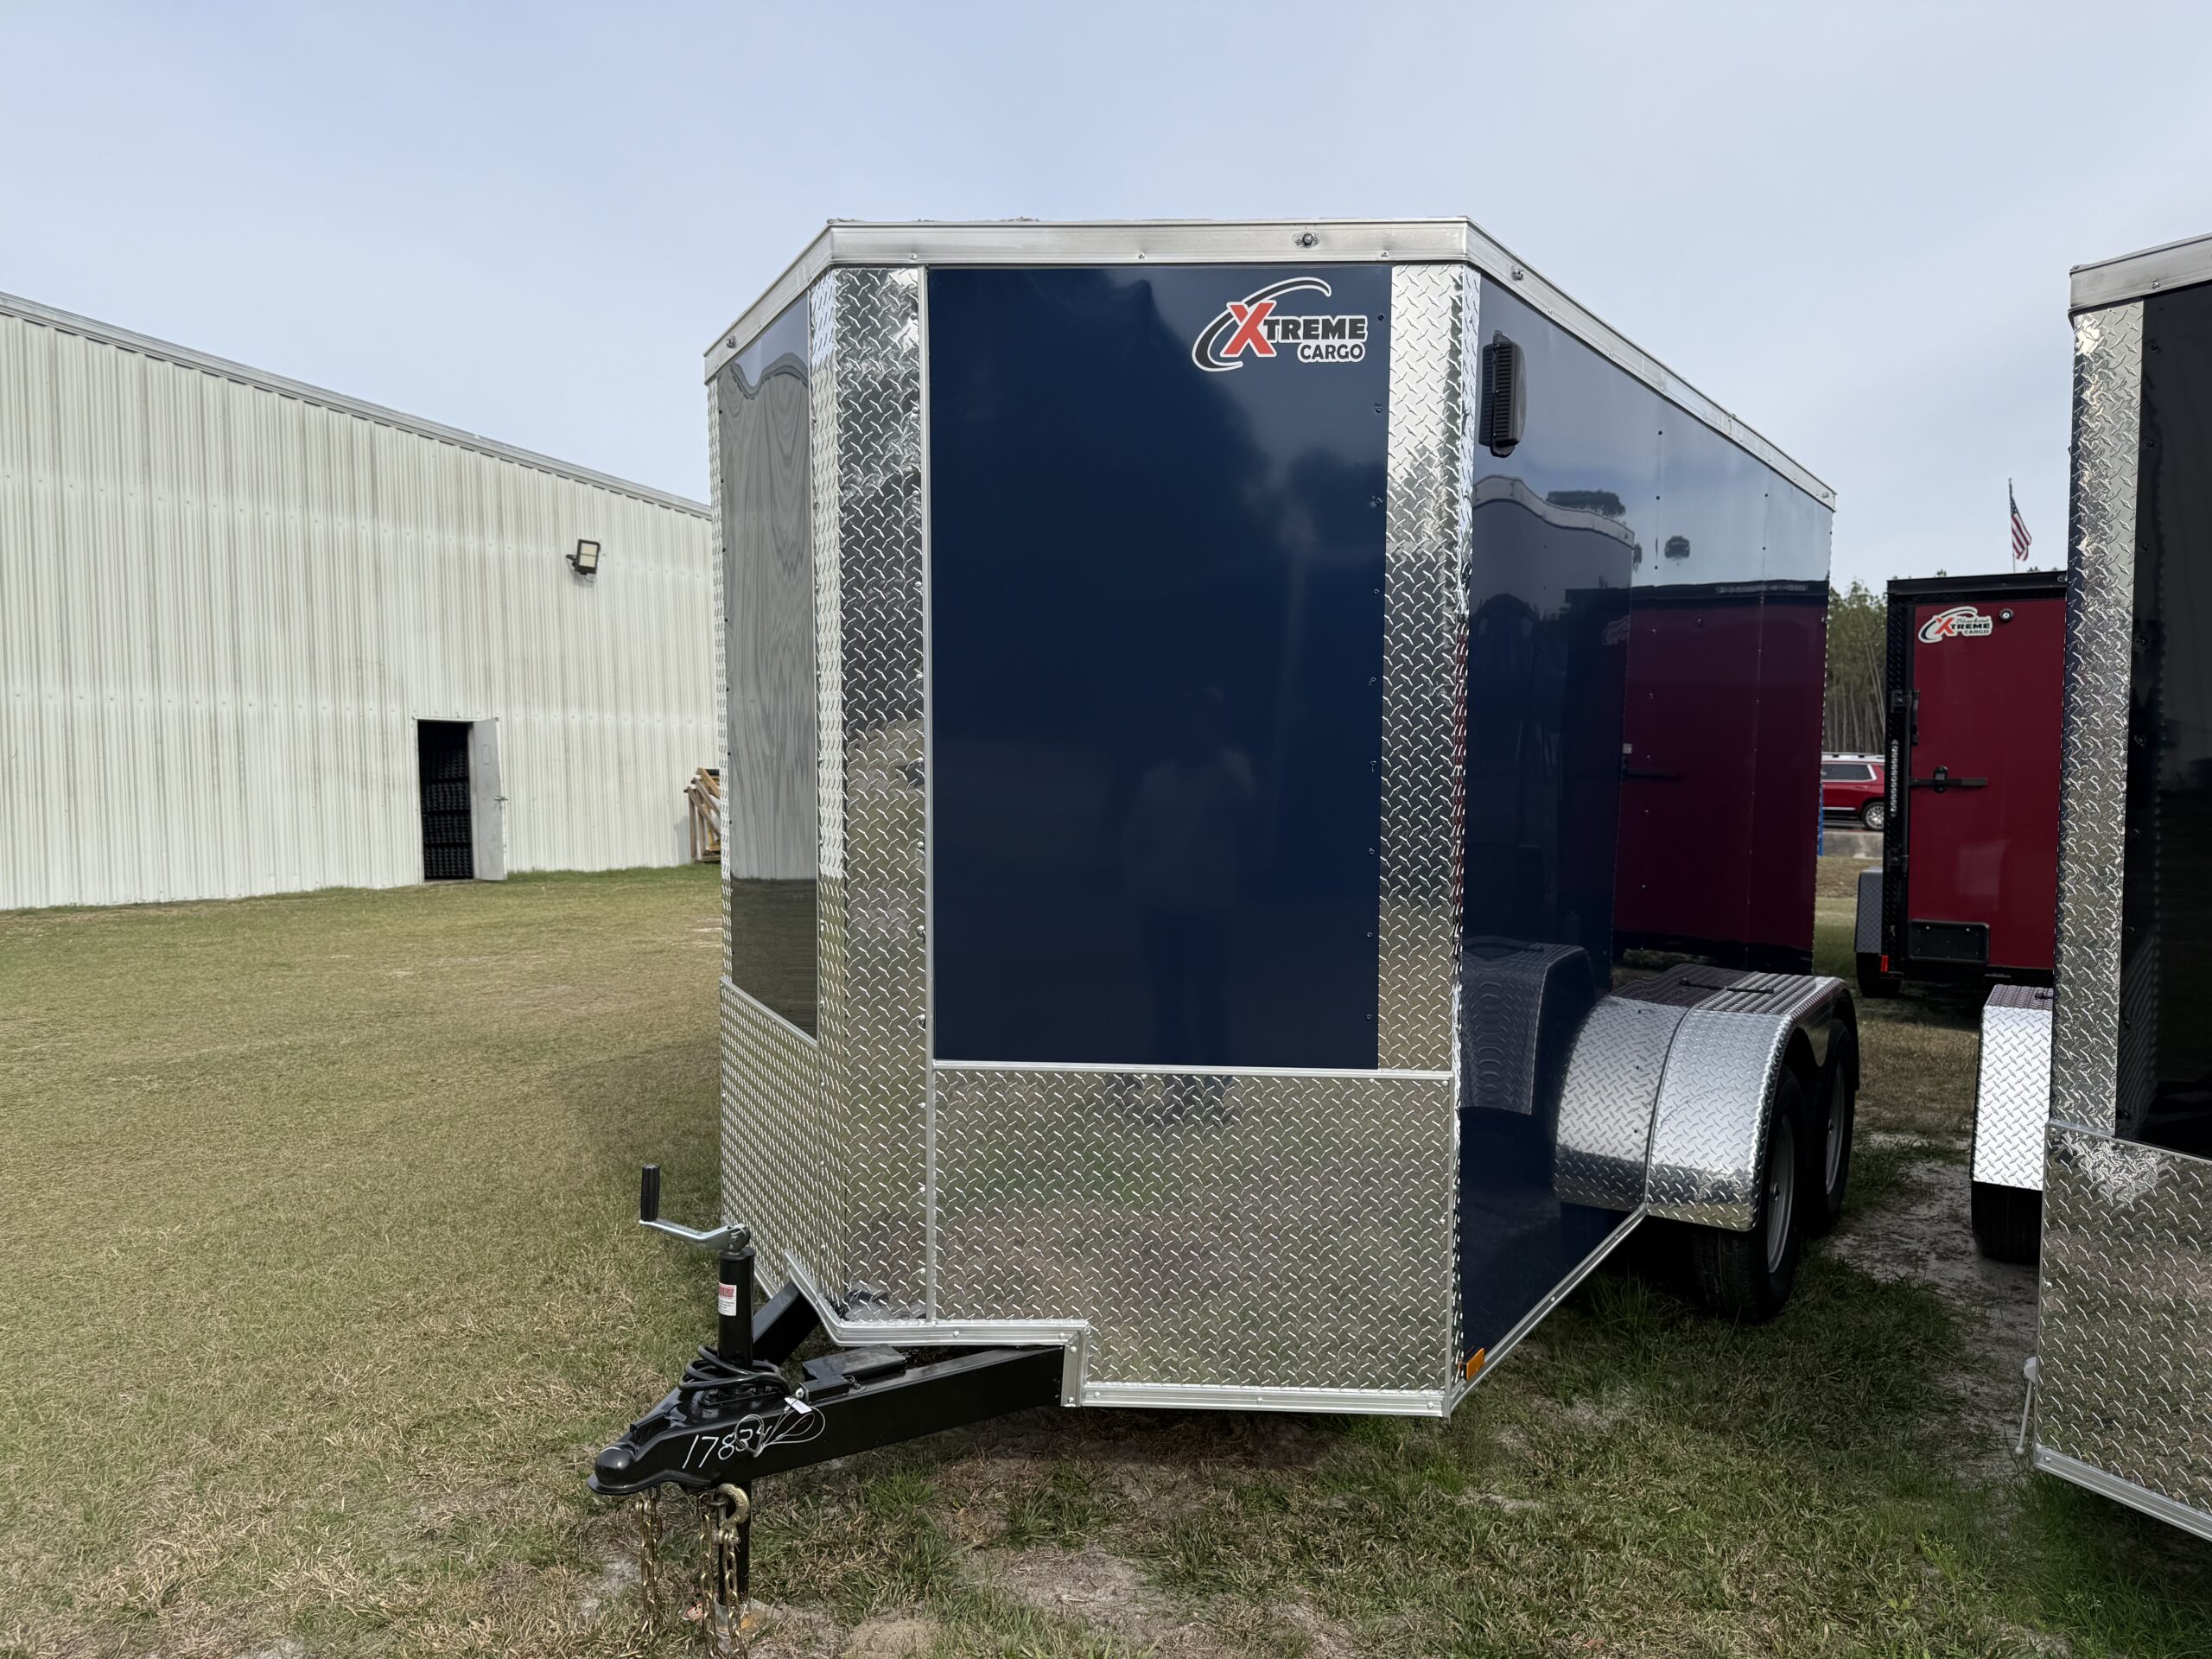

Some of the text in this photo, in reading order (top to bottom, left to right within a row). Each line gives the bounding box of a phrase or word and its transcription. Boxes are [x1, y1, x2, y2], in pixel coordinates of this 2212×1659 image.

[1221, 301, 1368, 356] XTREME
[1298, 342, 1364, 361] CARGO
[1935, 617, 1990, 635] XTREME
